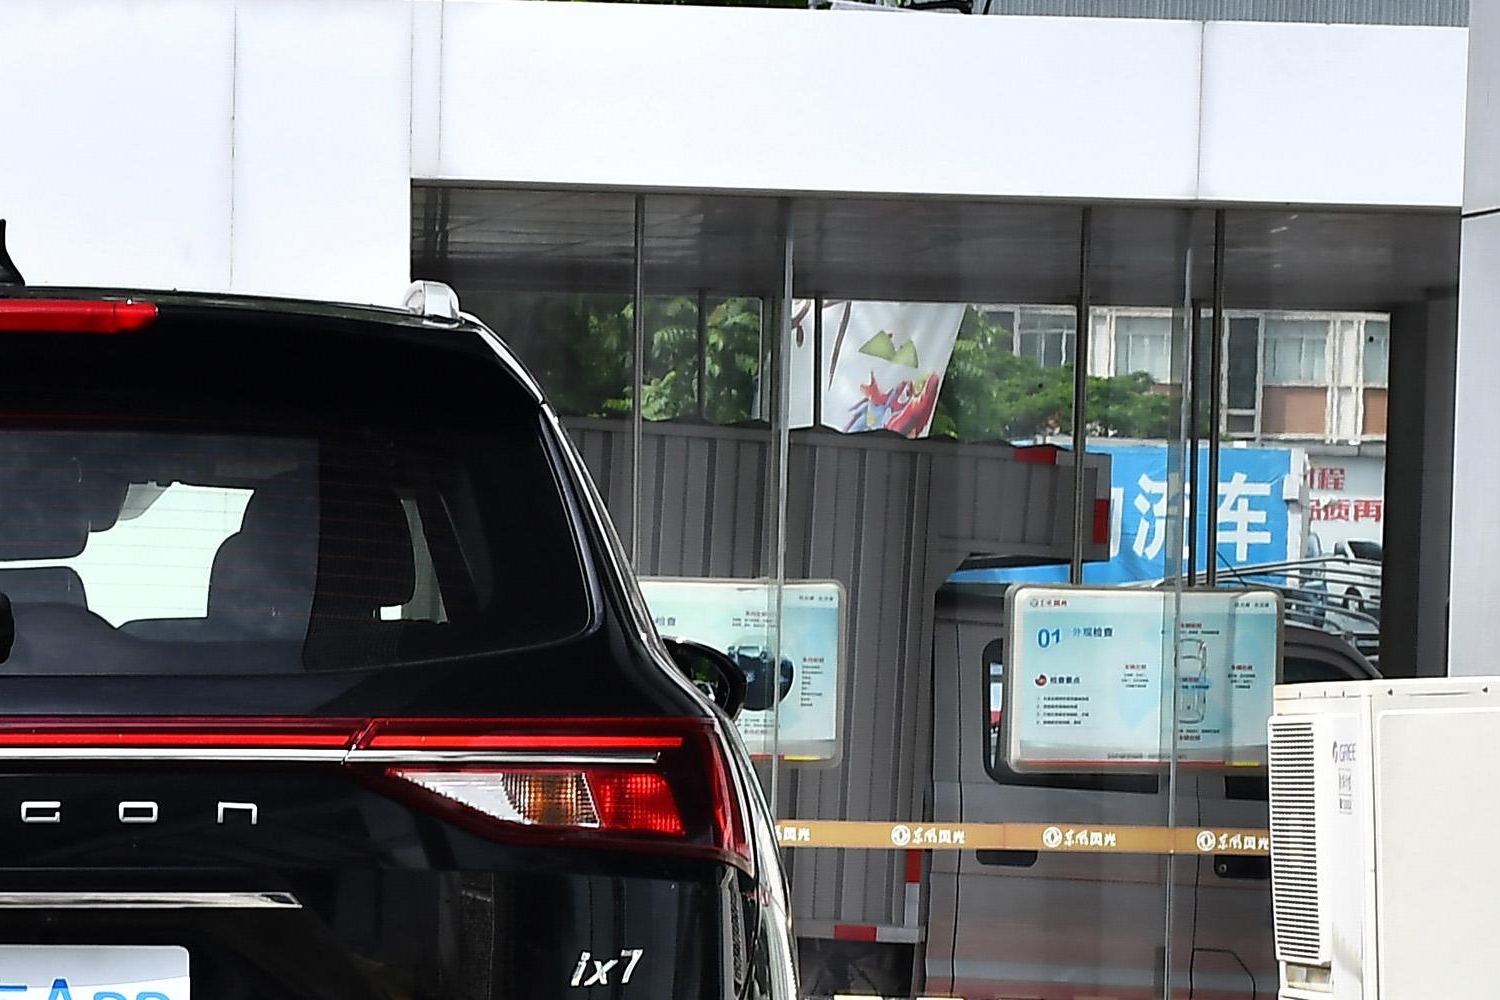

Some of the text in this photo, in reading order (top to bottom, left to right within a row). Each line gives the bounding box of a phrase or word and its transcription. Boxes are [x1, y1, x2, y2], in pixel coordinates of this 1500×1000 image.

[1038, 628, 1061, 648] 01
[1339, 742, 1356, 762] GREE
[570, 949, 644, 987] ix7
